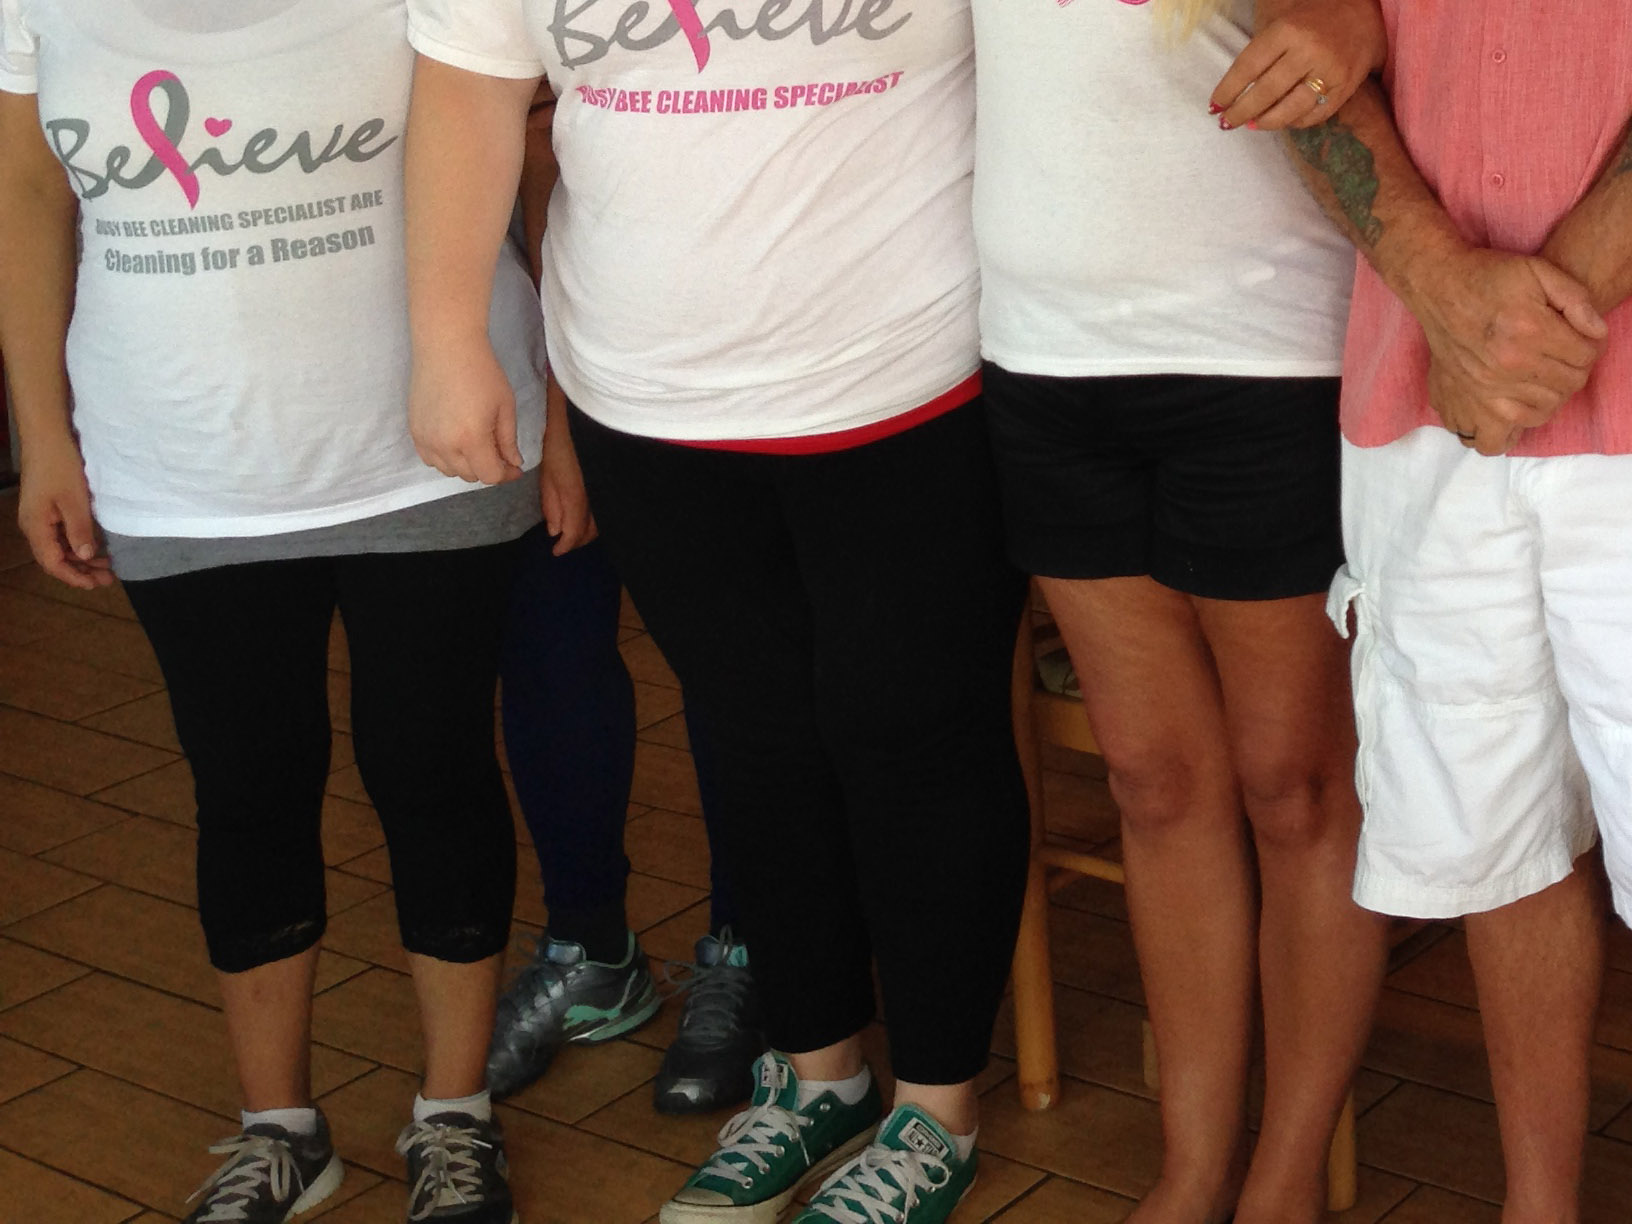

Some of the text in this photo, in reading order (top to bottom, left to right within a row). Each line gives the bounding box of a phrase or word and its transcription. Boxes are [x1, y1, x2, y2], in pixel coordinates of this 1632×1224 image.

[614, 89, 652, 114] BEE
[656, 87, 767, 115] CLEANING
[773, 70, 904, 110] SPECIALIST
[46, 69, 399, 210] Believe
[123, 220, 148, 237] BEE
[149, 213, 234, 237] CLEANING
[237, 196, 346, 229] SPECIALIST
[350, 189, 384, 211] ARE
[104, 225, 376, 276] Cleaning for a Reason
